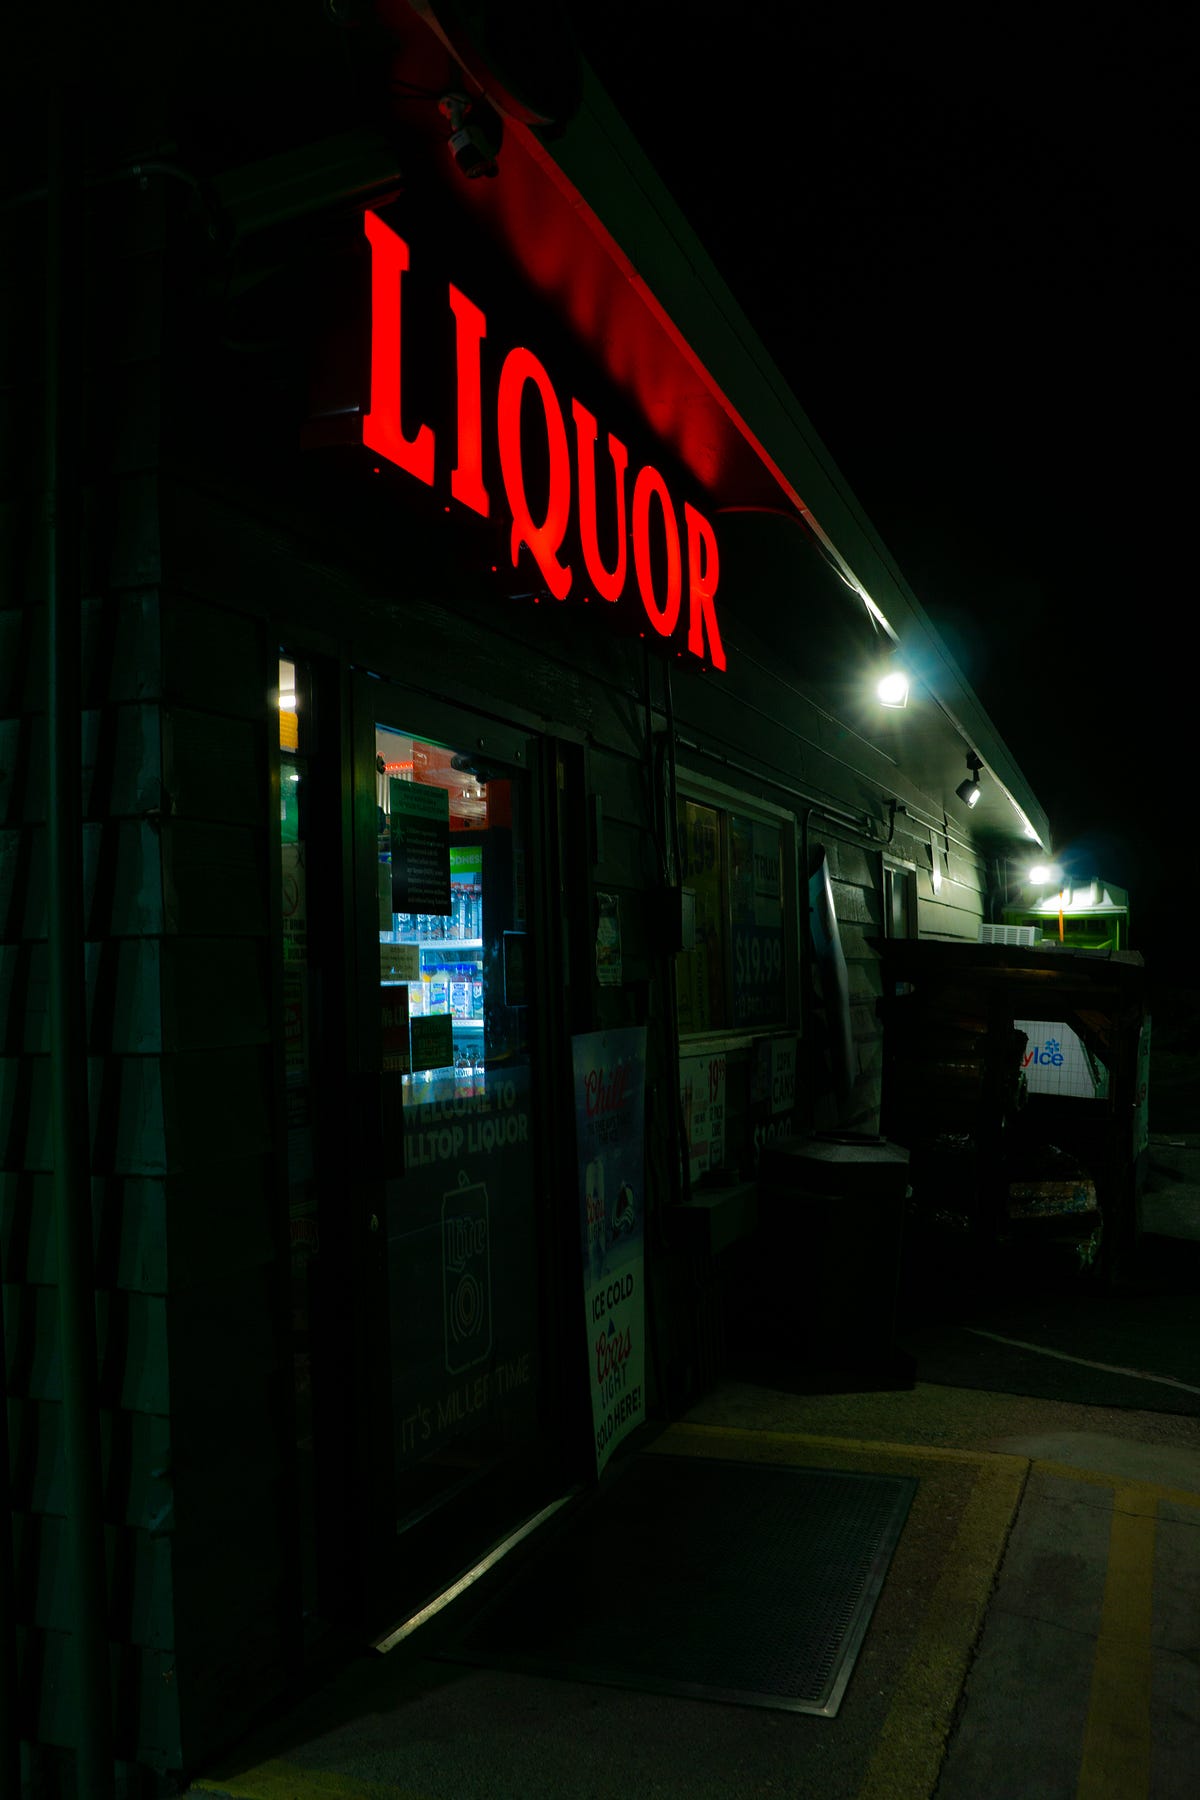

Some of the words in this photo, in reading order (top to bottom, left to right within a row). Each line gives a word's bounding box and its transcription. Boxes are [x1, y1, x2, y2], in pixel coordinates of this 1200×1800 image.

[363, 208, 727, 673] LIQUOR
[735, 930, 782, 988] $19.99
[496, 1080, 517, 1112] TO
[467, 1113, 529, 1155] LIQUOR
[592, 1288, 605, 1323] ICE
[606, 1273, 634, 1309] COLD
[596, 1326, 632, 1385] Coors
[601, 1362, 627, 1409] LIGHT
[614, 1385, 642, 1426] HERE!
